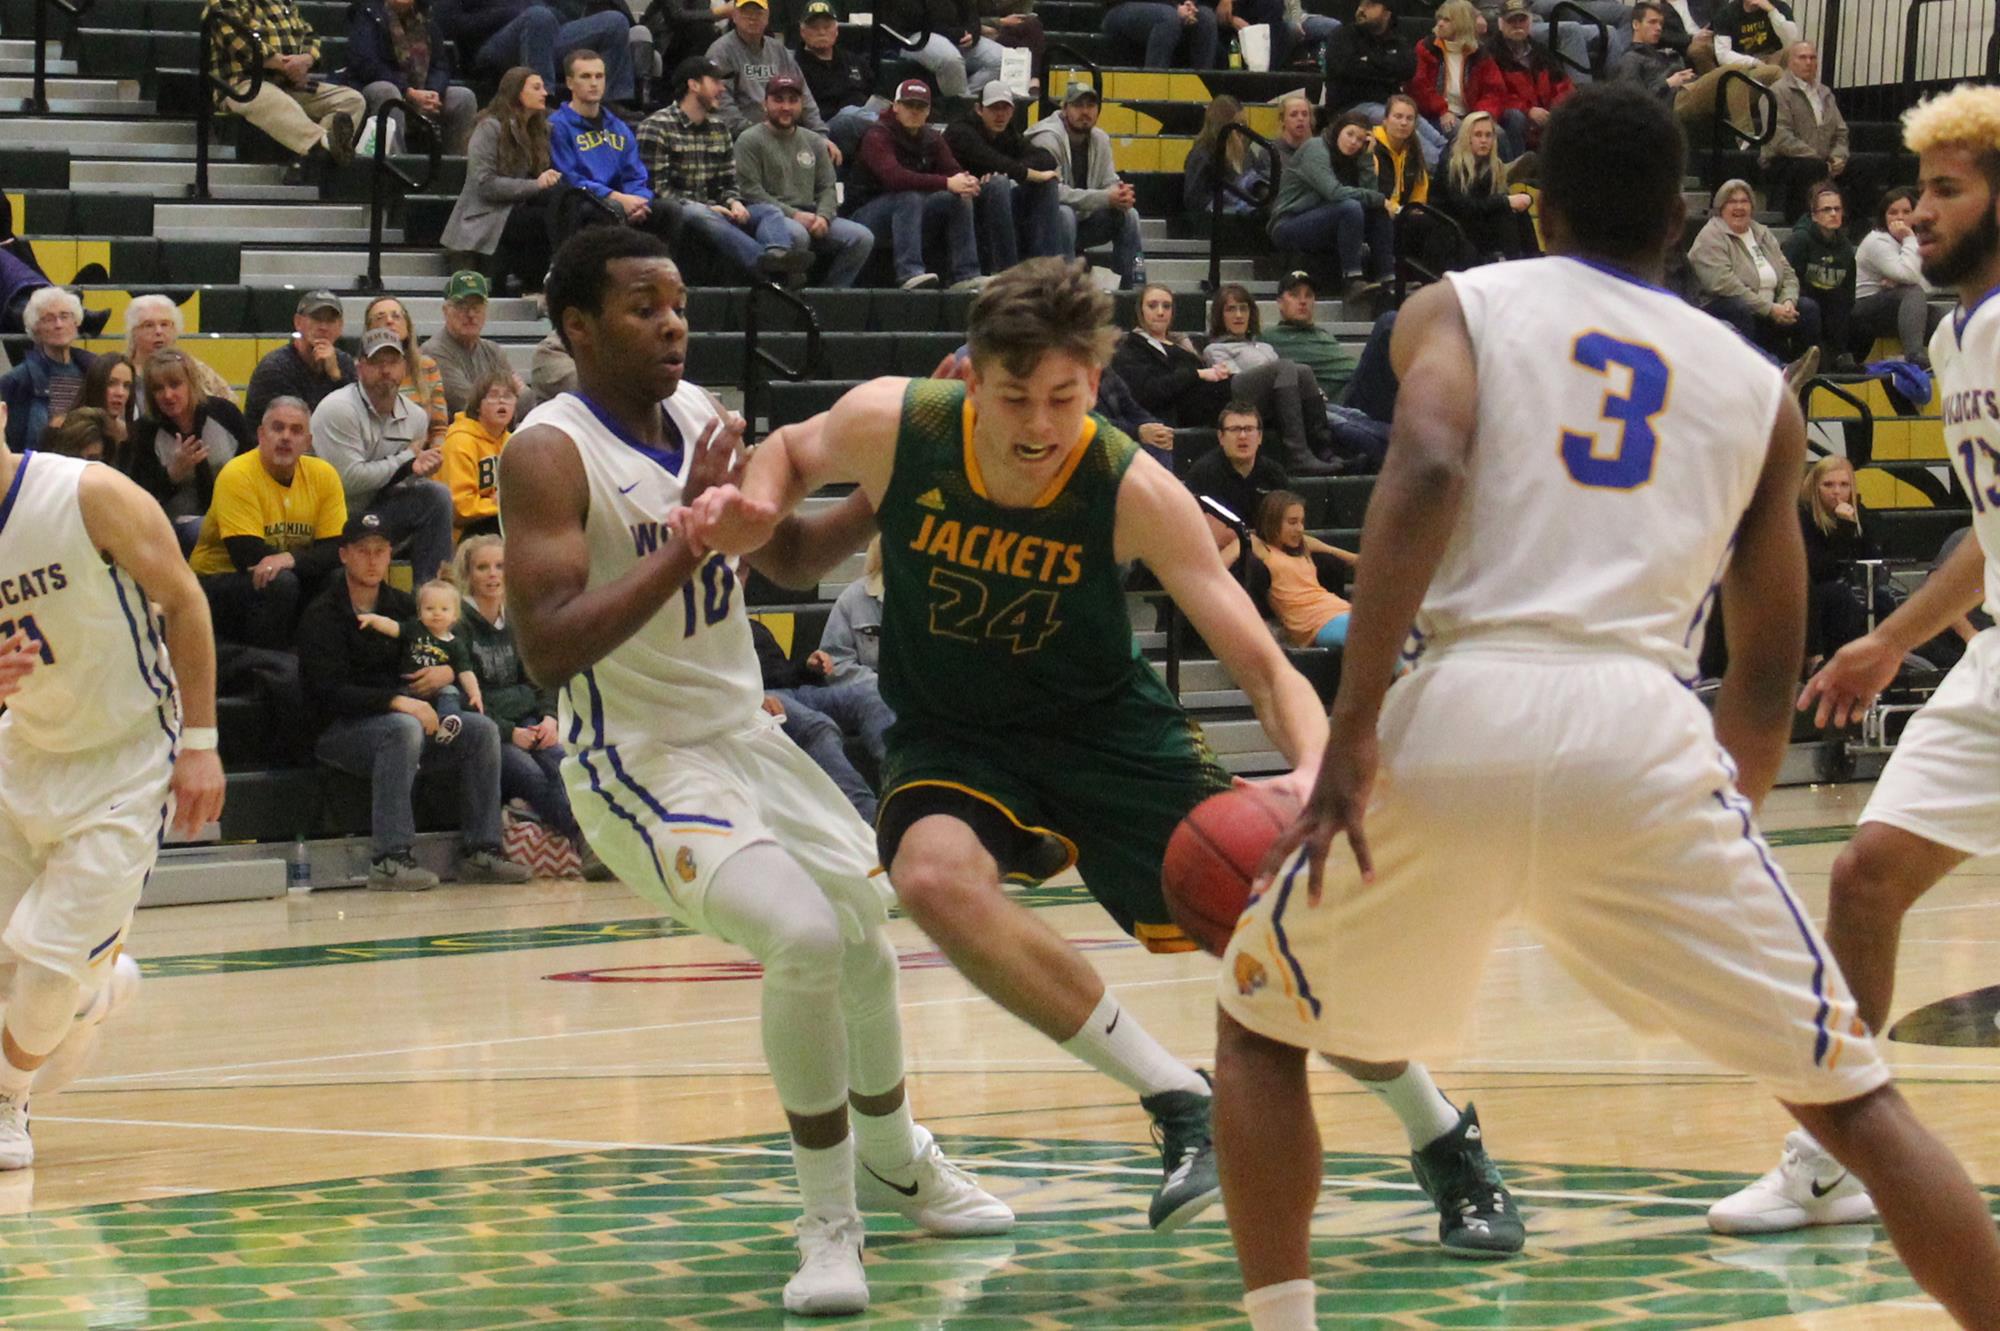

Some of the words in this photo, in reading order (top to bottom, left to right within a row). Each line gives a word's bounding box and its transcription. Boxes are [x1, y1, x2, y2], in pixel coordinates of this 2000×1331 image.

[1556, 327, 1674, 494] 3
[478, 456, 497, 491] B
[0, 562, 68, 609] CATS
[909, 513, 1083, 586] JACKETS
[682, 551, 735, 639] 10
[928, 566, 1063, 655] 24
